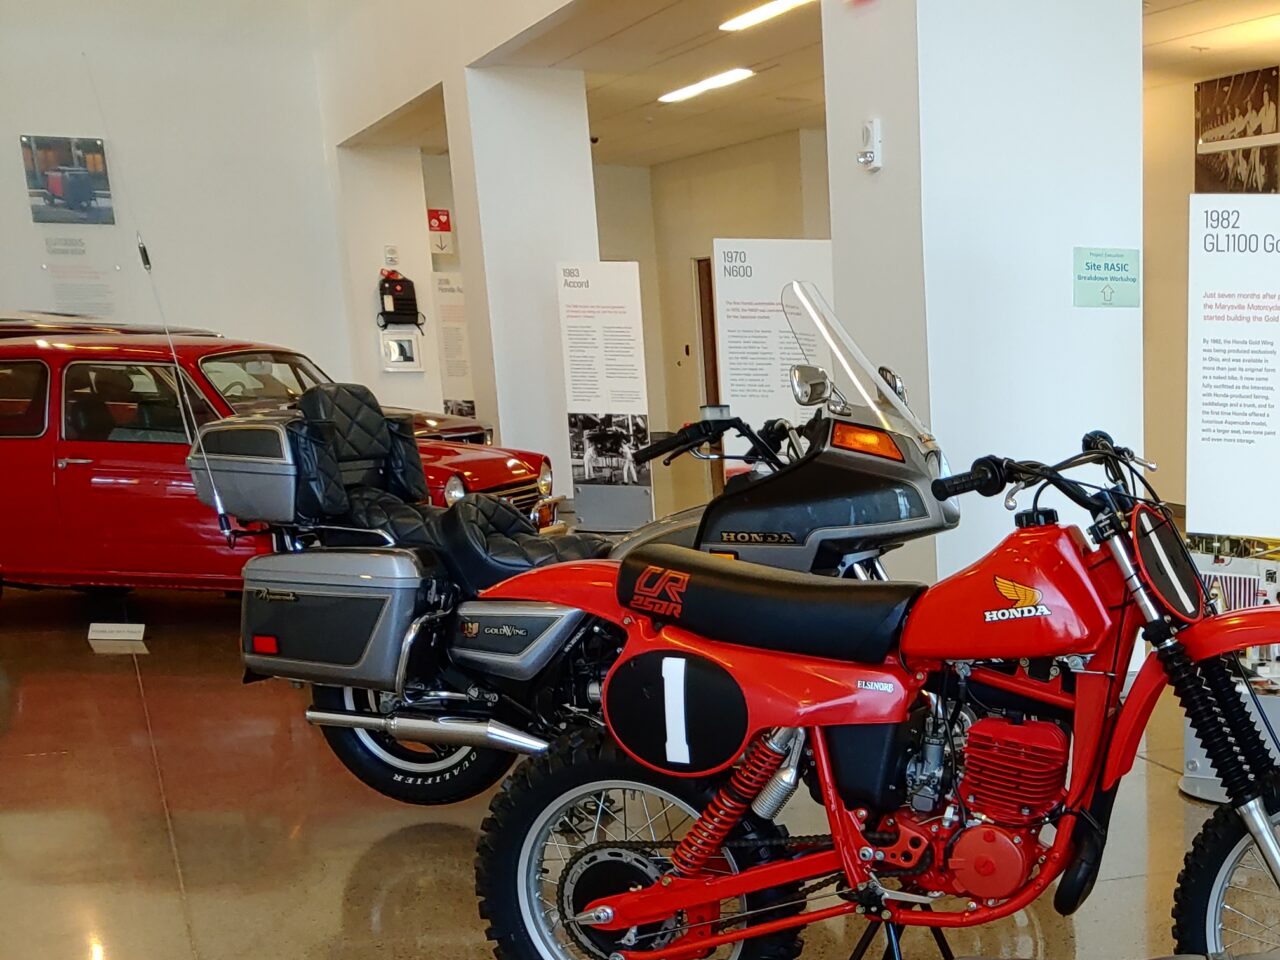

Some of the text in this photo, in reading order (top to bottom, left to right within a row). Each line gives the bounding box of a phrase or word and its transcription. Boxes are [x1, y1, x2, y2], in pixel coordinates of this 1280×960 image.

[1203, 209, 1241, 229] 1982
[1203, 233, 1259, 253] GL1100
[722, 250, 747, 263] 1970
[723, 265, 753, 278] N600
[1085, 261, 1129, 272] Site RASIC
[721, 532, 795, 543] HONDA
[984, 605, 1052, 622] HONDA
[392, 751, 477, 785] QUALIFIER
